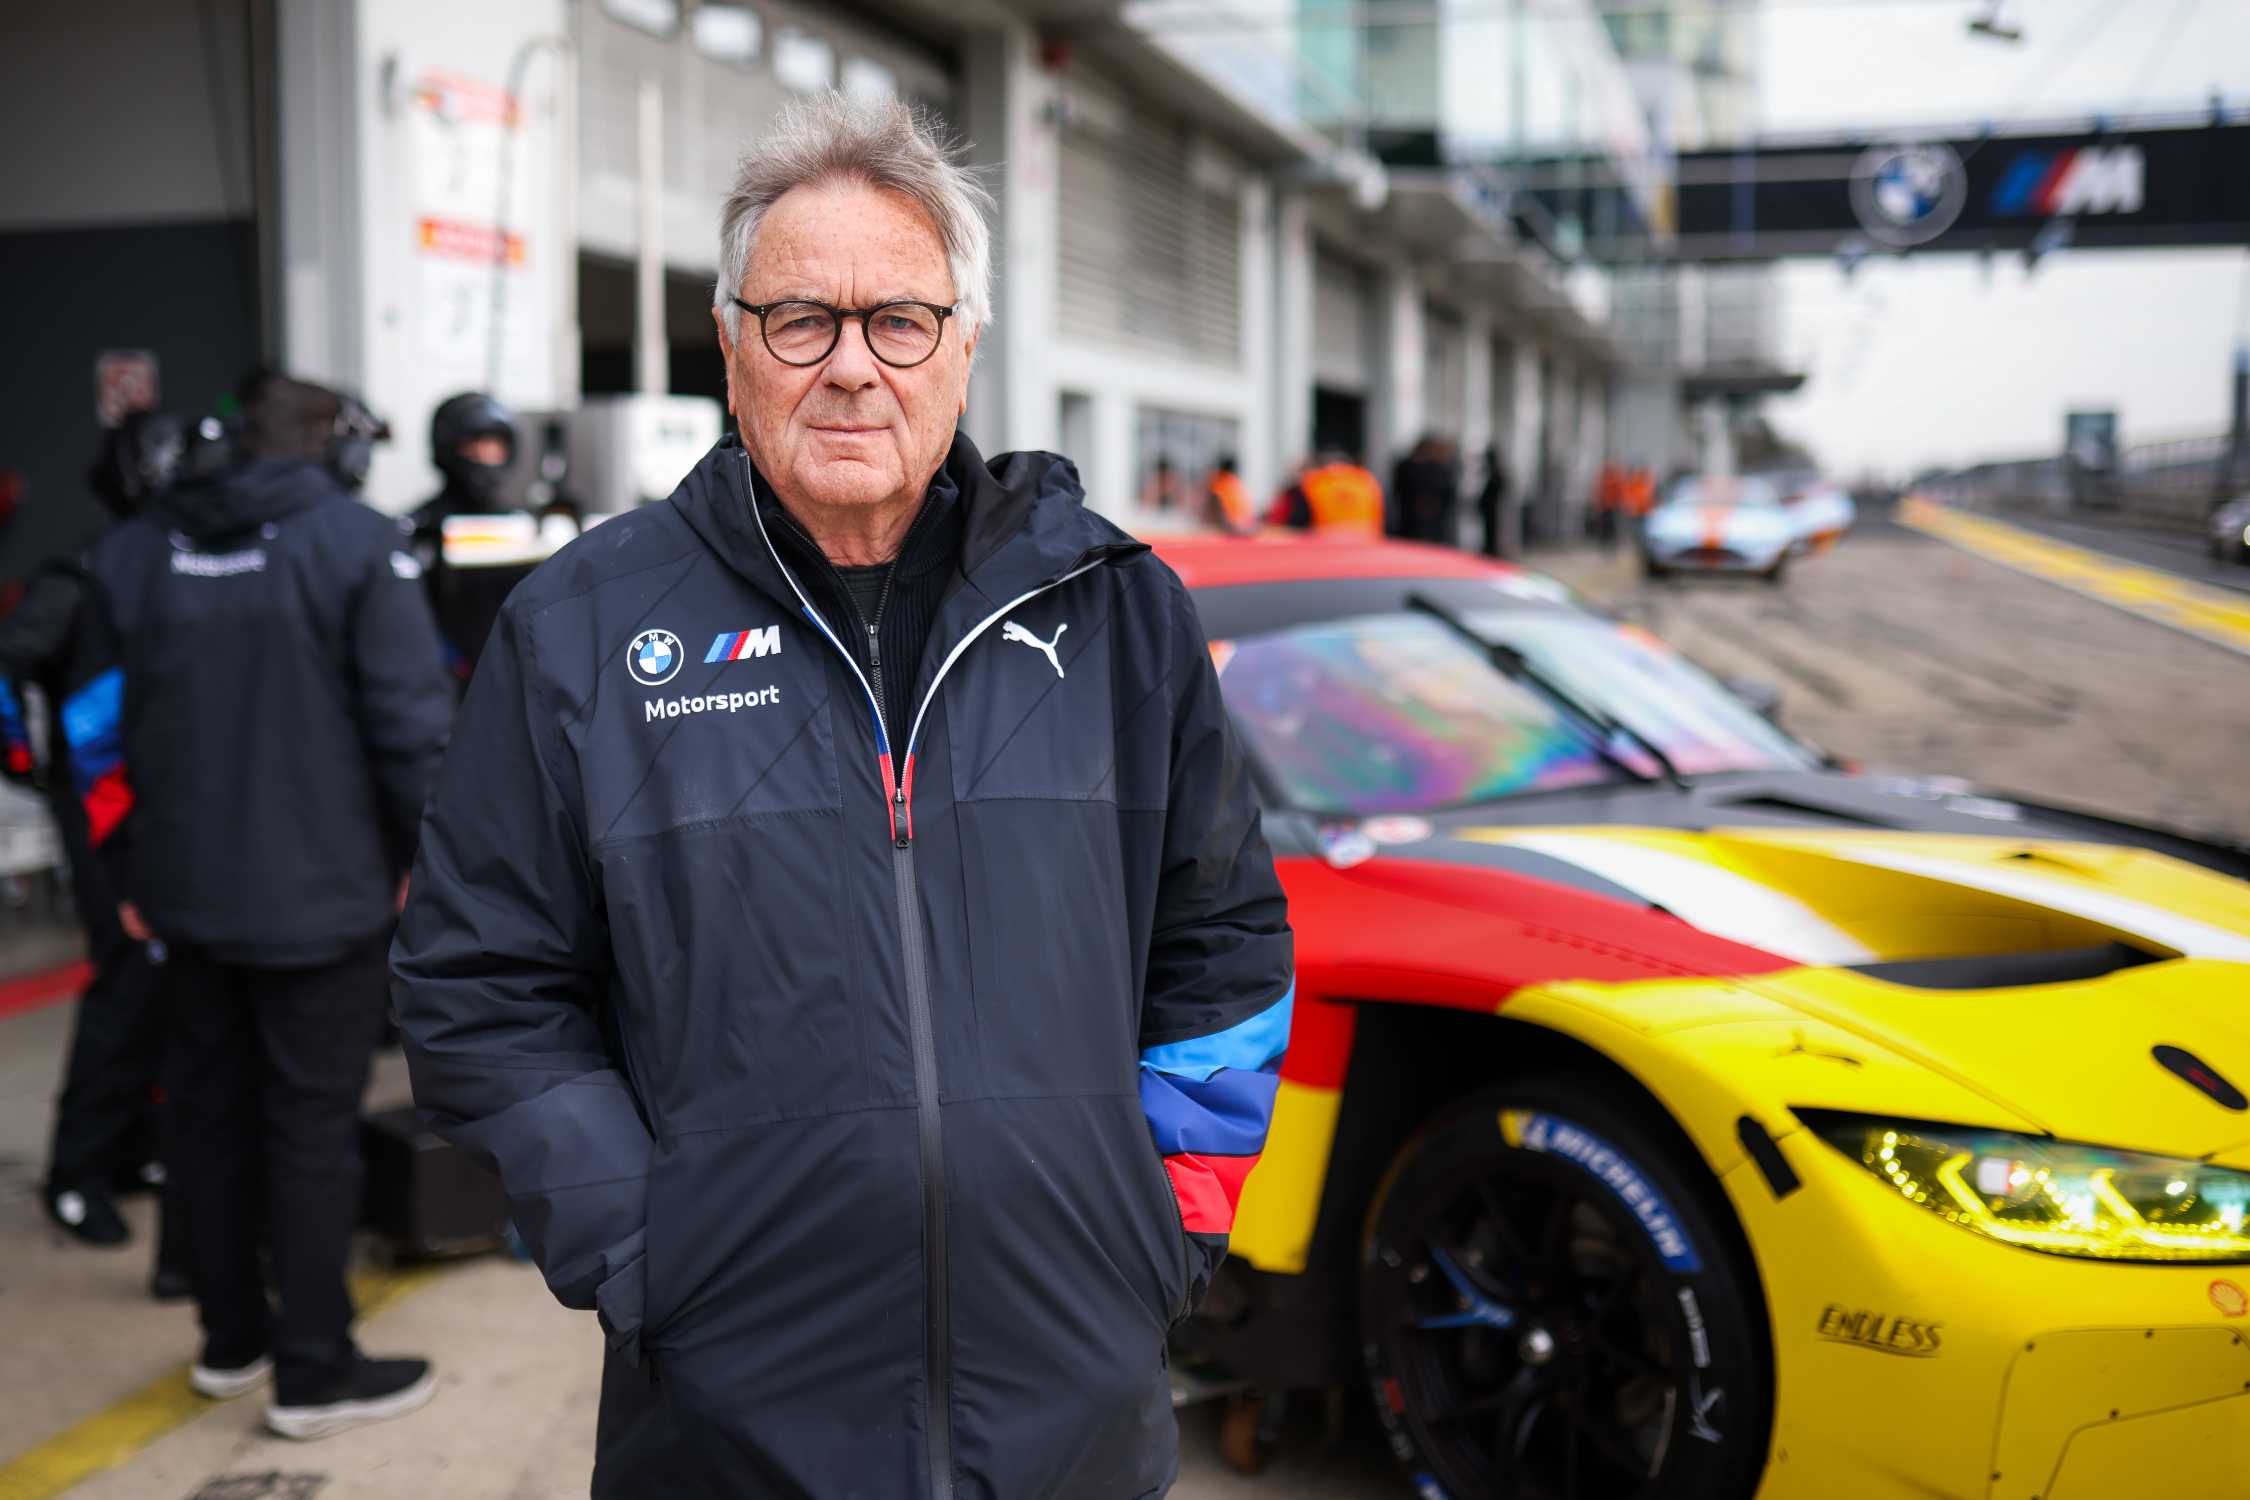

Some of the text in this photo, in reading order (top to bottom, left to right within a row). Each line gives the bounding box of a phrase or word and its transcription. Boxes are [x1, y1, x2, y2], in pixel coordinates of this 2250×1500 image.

[737, 625, 781, 660] M
[645, 685, 780, 722] Motorsport
[1552, 1124, 1688, 1258] MICHELIN
[1817, 1302, 1944, 1353] ENDLESS
